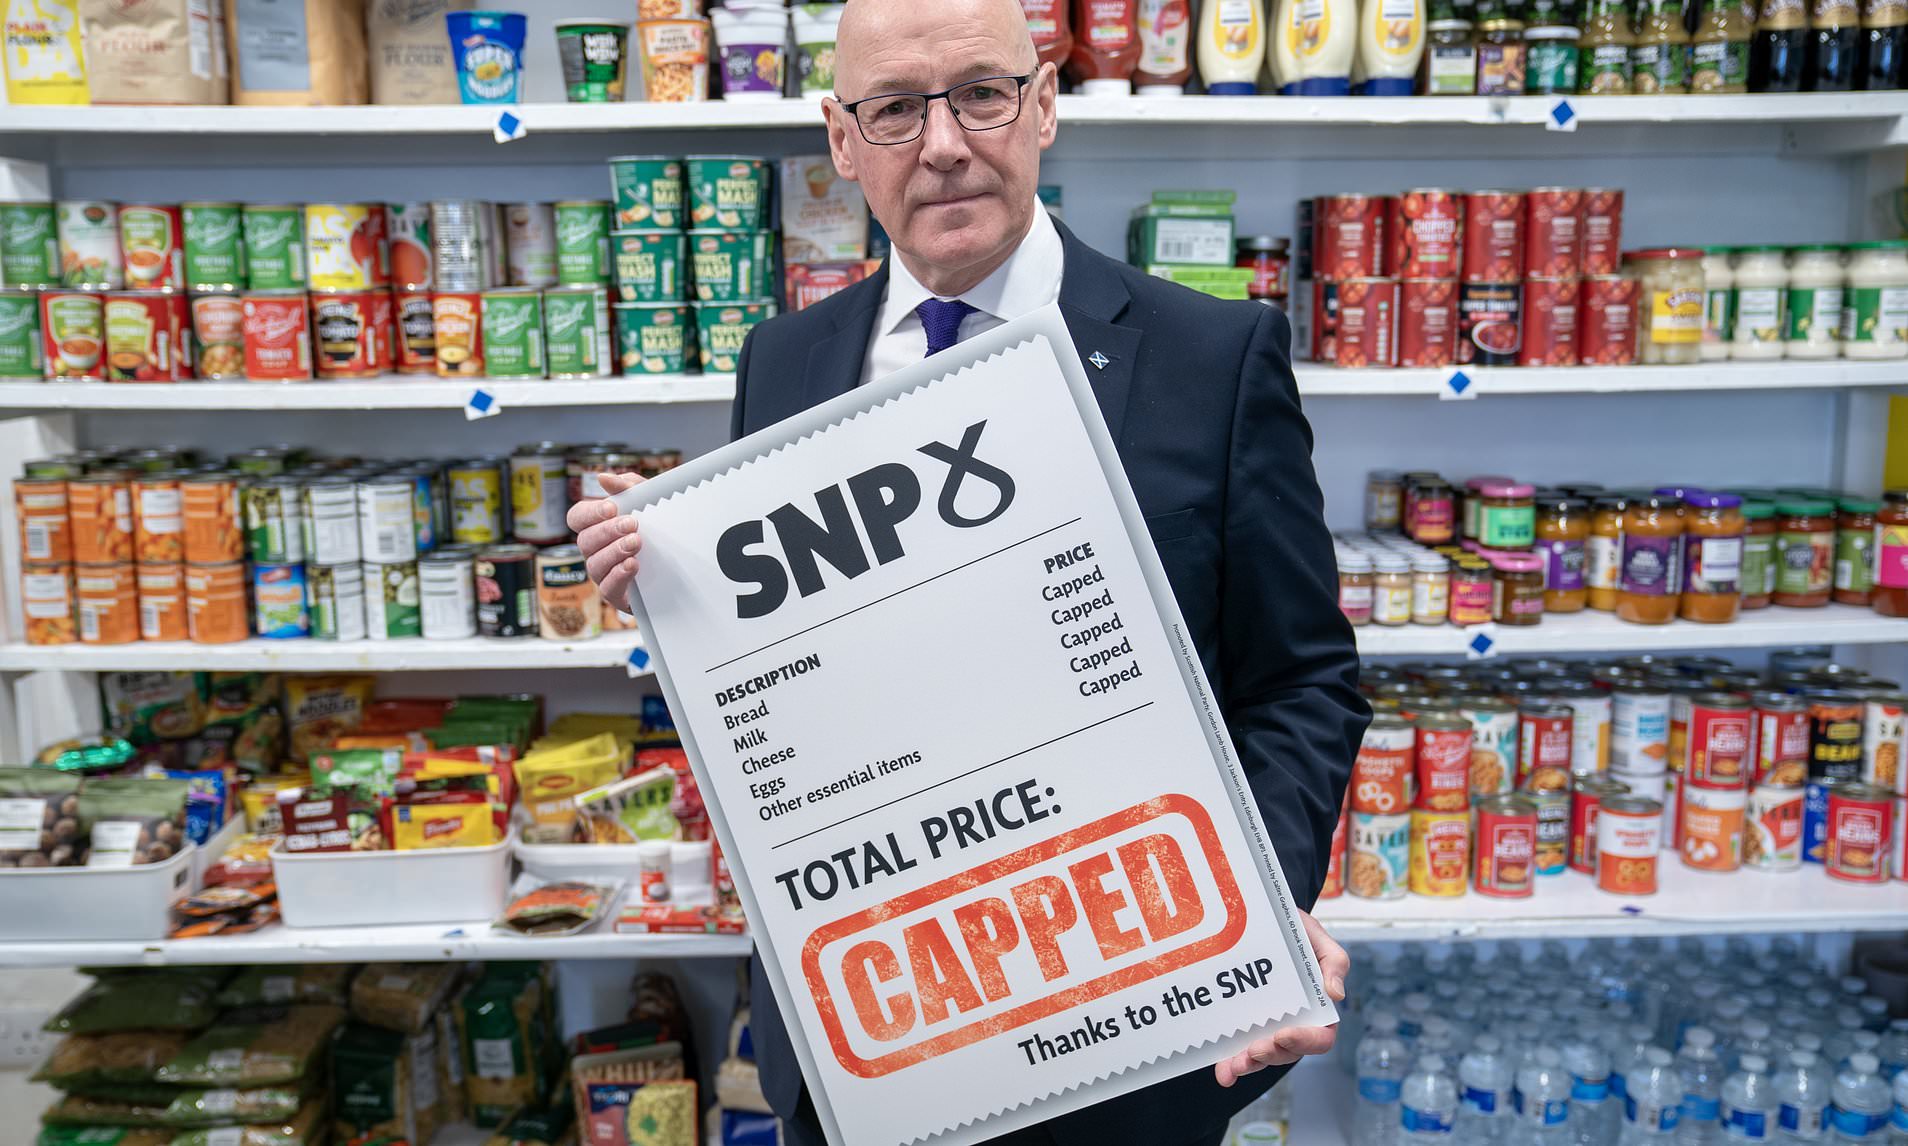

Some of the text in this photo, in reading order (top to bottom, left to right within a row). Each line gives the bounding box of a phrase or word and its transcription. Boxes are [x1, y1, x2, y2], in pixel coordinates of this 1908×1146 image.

[716, 462, 922, 619] SNP
[1043, 541, 1095, 574] PRICE
[1042, 564, 1105, 602] Capped
[1051, 588, 1114, 626] Capped
[1060, 612, 1124, 649] Capped
[1070, 636, 1133, 673] Capped
[714, 653, 822, 708] DESCRIPTION
[1079, 660, 1143, 697] Capped
[723, 699, 770, 730] Bread
[732, 728, 769, 753] Milk
[741, 746, 797, 776] Cheese
[749, 775, 786, 800] Eggs
[758, 749, 922, 822] Other essential items
[1171, 623, 1186, 648] Promoted
[1184, 654, 1197, 676] Scottish
[1192, 675, 1205, 696] National
[1206, 710, 1219, 731] Gordon
[1214, 730, 1224, 745] Lamb
[1242, 805, 1259, 832] Edinburgh
[1262, 853, 1274, 872] Printed
[1272, 878, 1284, 896] Saltire
[1291, 928, 1302, 944] Brook
[1303, 960, 1317, 984] Glasgow
[775, 778, 1062, 911] TOTAL PRICE:
[840, 833, 1206, 1043] CAPPED
[1017, 957, 1274, 1066] Thanks to the SNP
